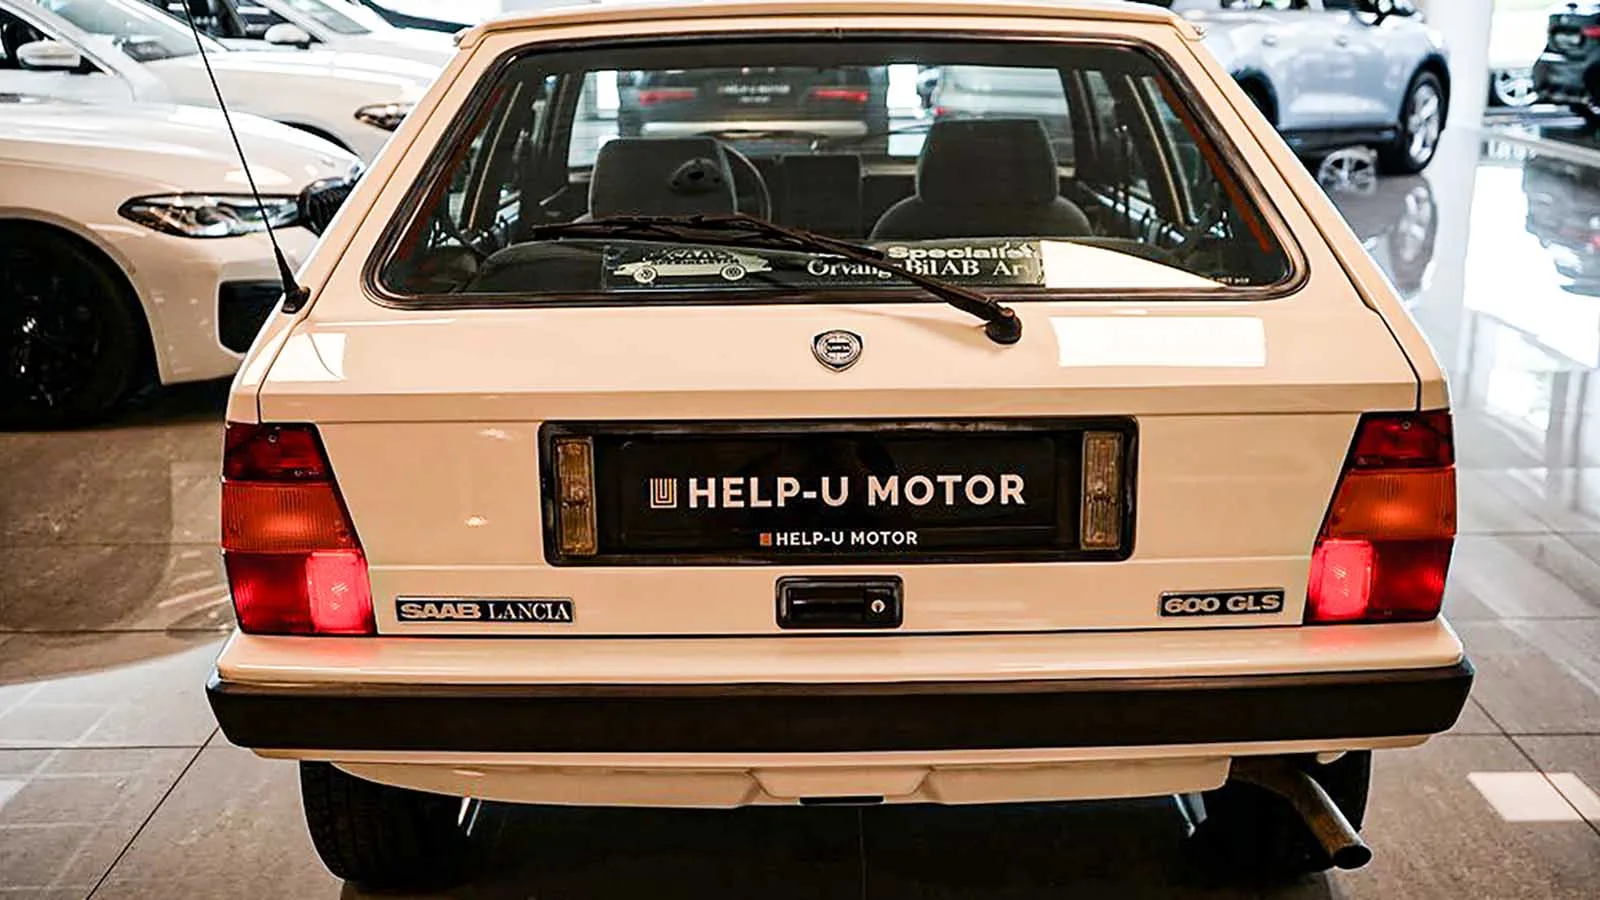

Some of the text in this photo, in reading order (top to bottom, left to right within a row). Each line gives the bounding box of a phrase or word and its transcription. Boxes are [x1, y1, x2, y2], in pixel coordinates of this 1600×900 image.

[688, 474, 1026, 508] HELP-U MOTOR
[775, 531, 919, 547] HELP-U MOTOR
[400, 602, 571, 620] SAAB LANCIA
[1164, 594, 1281, 614] 600 GLS
